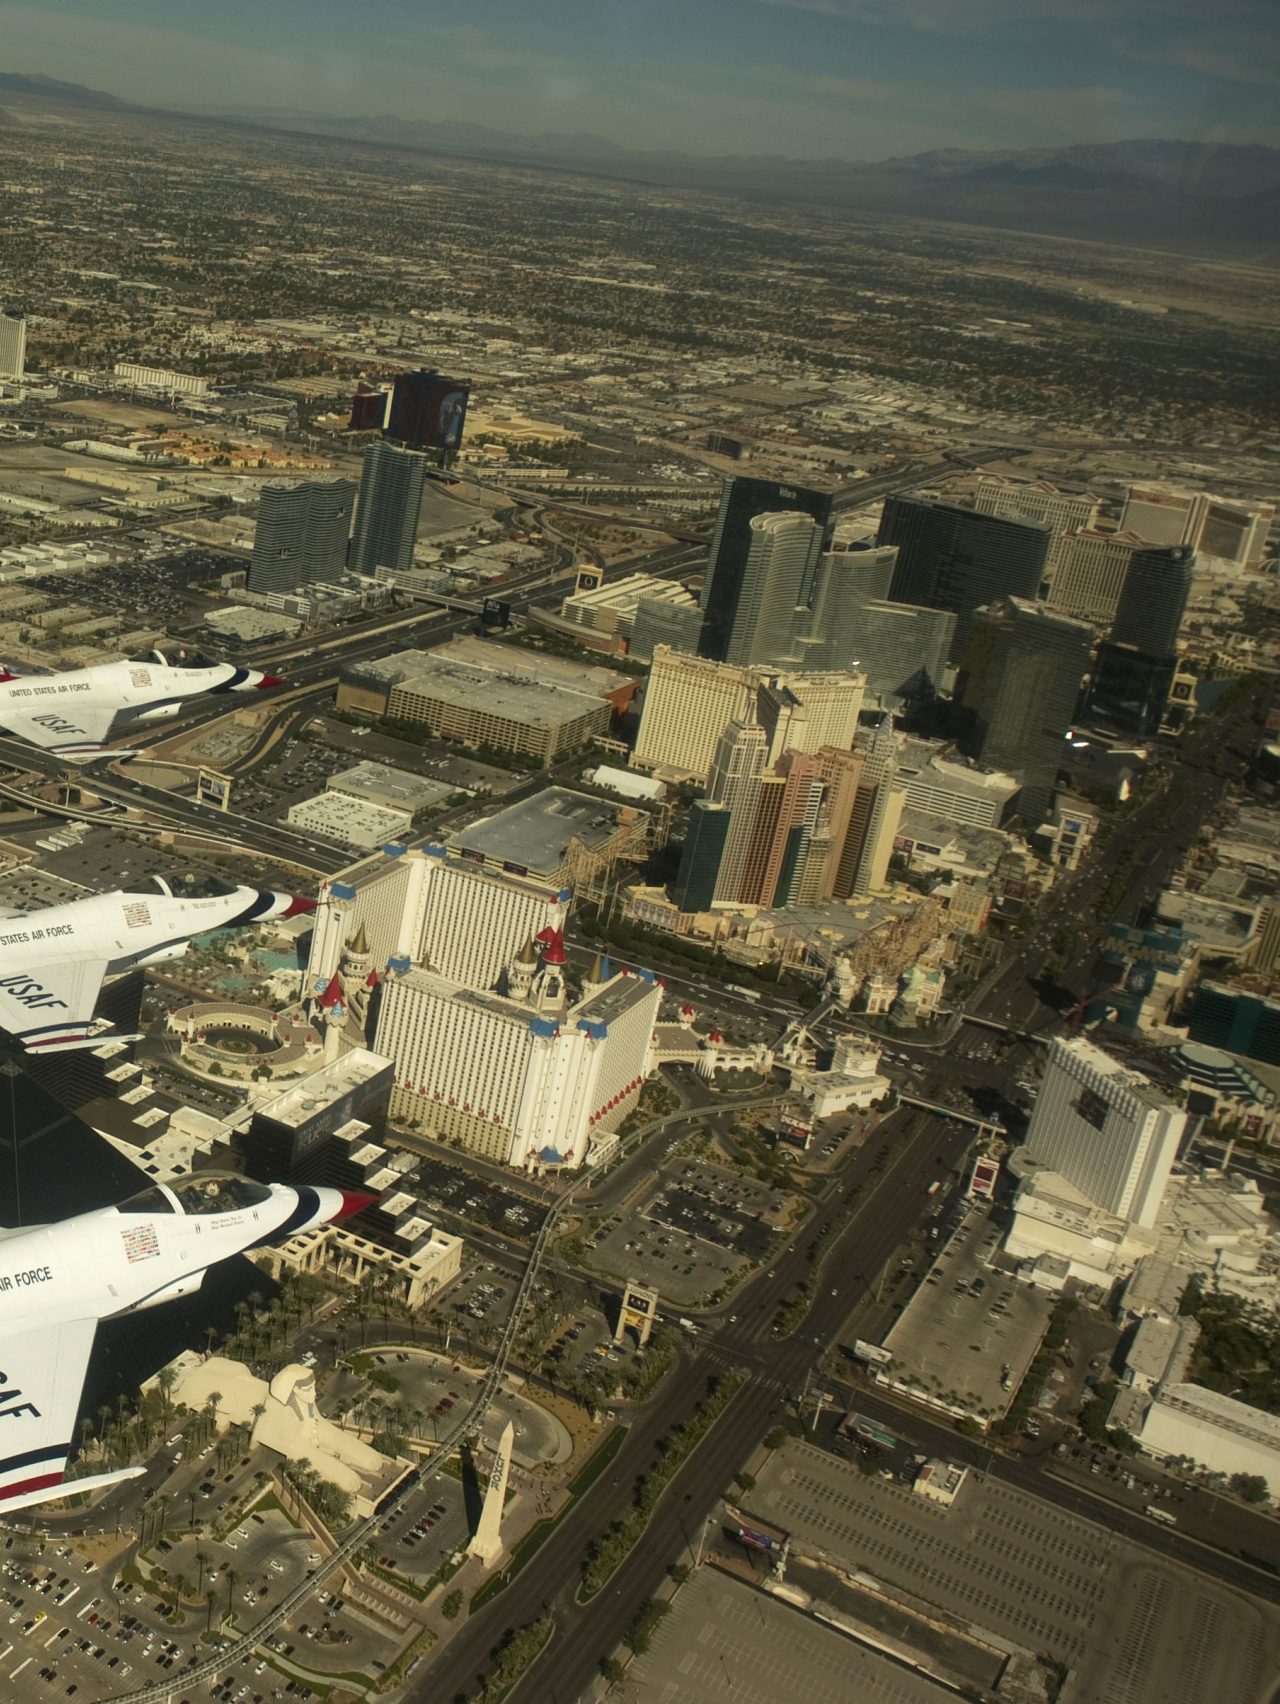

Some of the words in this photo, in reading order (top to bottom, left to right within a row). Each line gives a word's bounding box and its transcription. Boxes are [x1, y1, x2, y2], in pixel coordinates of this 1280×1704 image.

[9, 688, 32, 697] UNITED
[33, 686, 57, 695] STATES
[58, 685, 68, 693] AIR
[69, 683, 91, 692] FORCE
[31, 714, 87, 734] USAF
[0, 932, 30, 946] STATES
[31, 929, 45, 940] AIR
[46, 924, 74, 937] FORCE
[14, 1266, 53, 1287] FORCE
[490, 1452, 505, 1492] LUXOR
